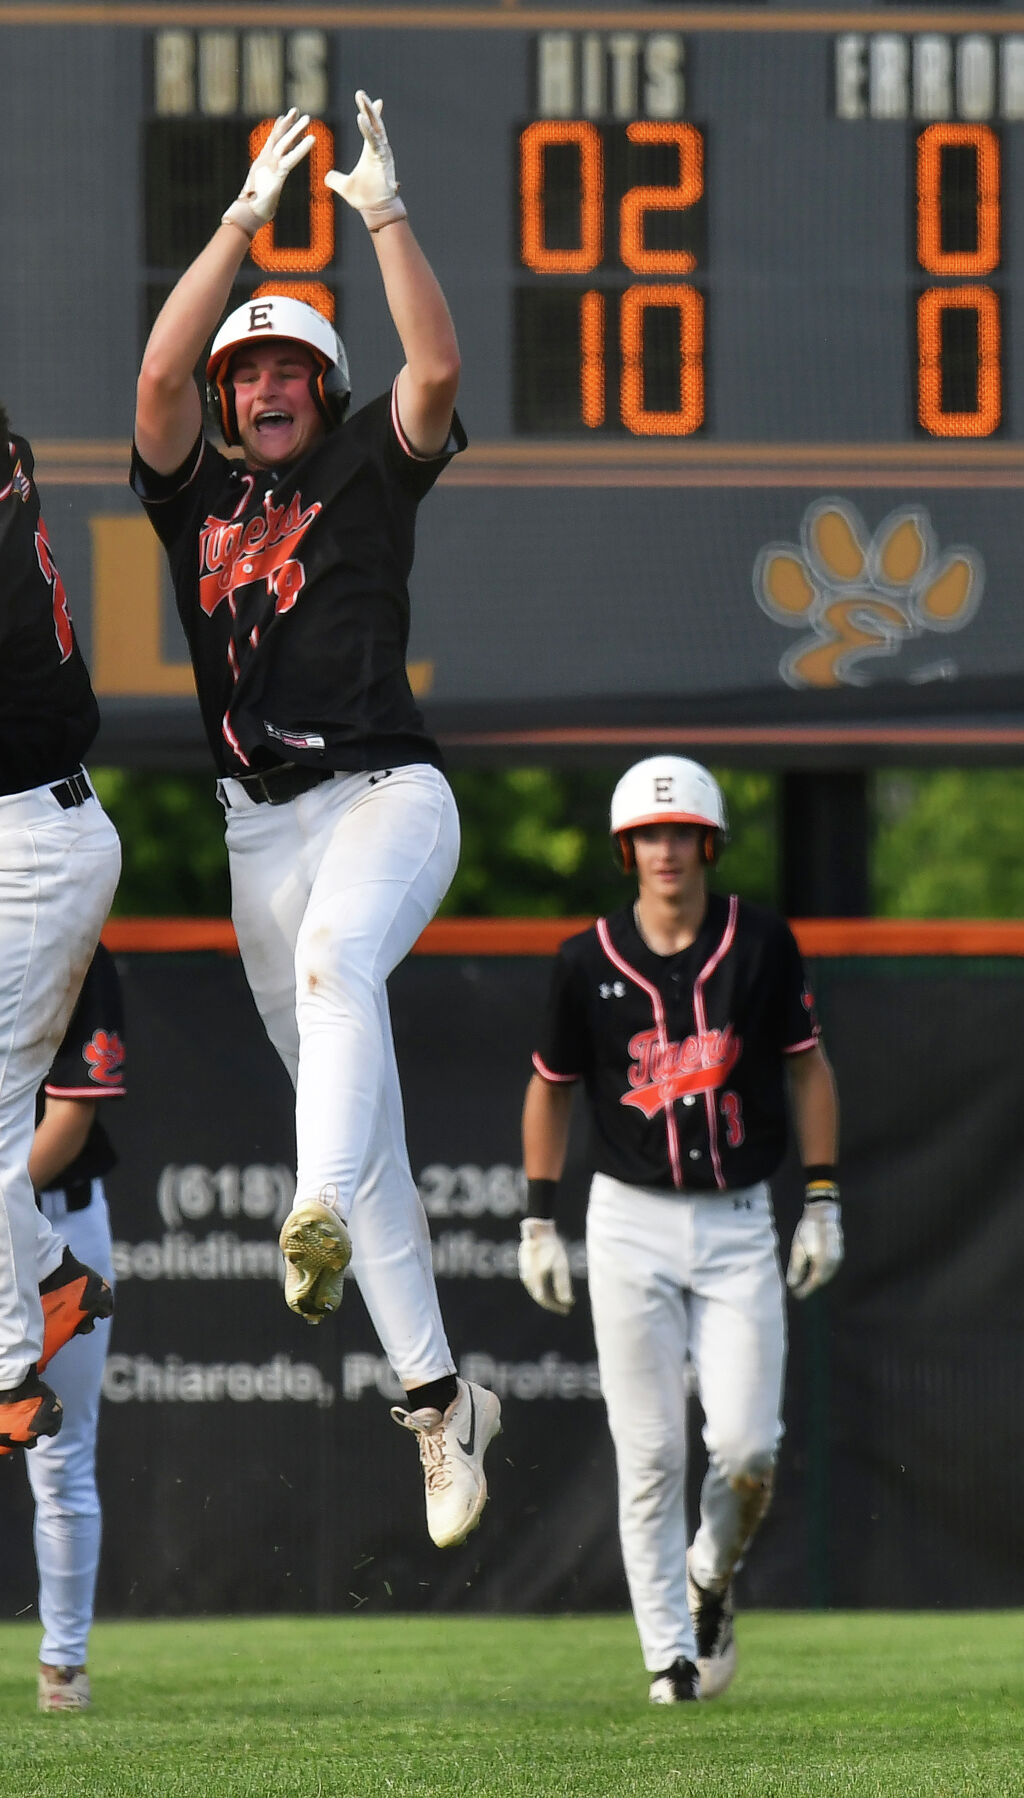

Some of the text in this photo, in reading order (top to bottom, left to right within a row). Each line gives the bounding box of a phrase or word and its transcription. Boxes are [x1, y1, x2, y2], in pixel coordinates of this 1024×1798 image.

[155, 31, 328, 116] RUNS
[537, 33, 685, 118] HITS
[248, 119, 334, 272] 0
[520, 120, 704, 275] 02
[917, 123, 1001, 277] 0
[248, 303, 273, 332] E
[581, 284, 705, 437] 10
[917, 286, 1002, 438] 0
[199, 490, 308, 592] Tigers
[653, 776, 674, 803] E
[627, 1024, 736, 1101] Tigers
[720, 1090, 745, 1148] 3
